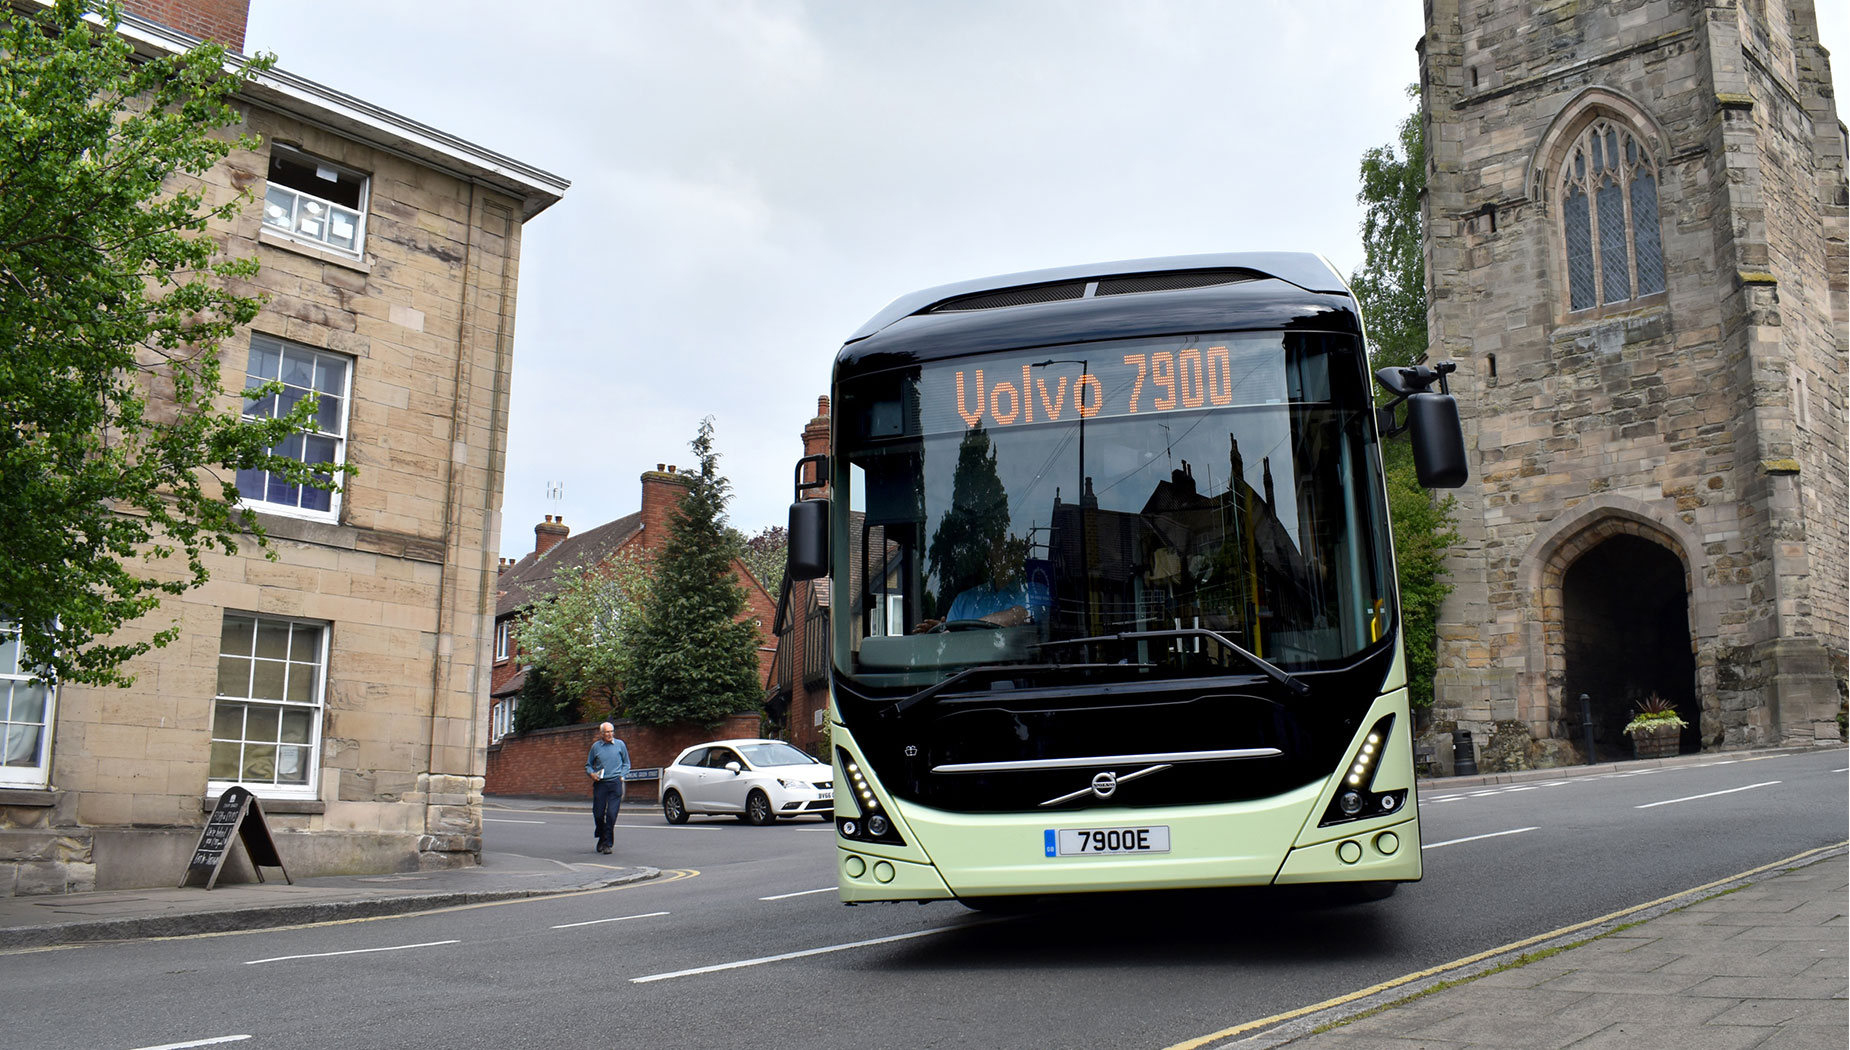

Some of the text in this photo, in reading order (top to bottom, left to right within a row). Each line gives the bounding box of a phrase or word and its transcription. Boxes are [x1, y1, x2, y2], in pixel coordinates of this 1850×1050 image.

[956, 346, 1232, 427] Volvo 7900
[1078, 829, 1150, 851] 7900E
